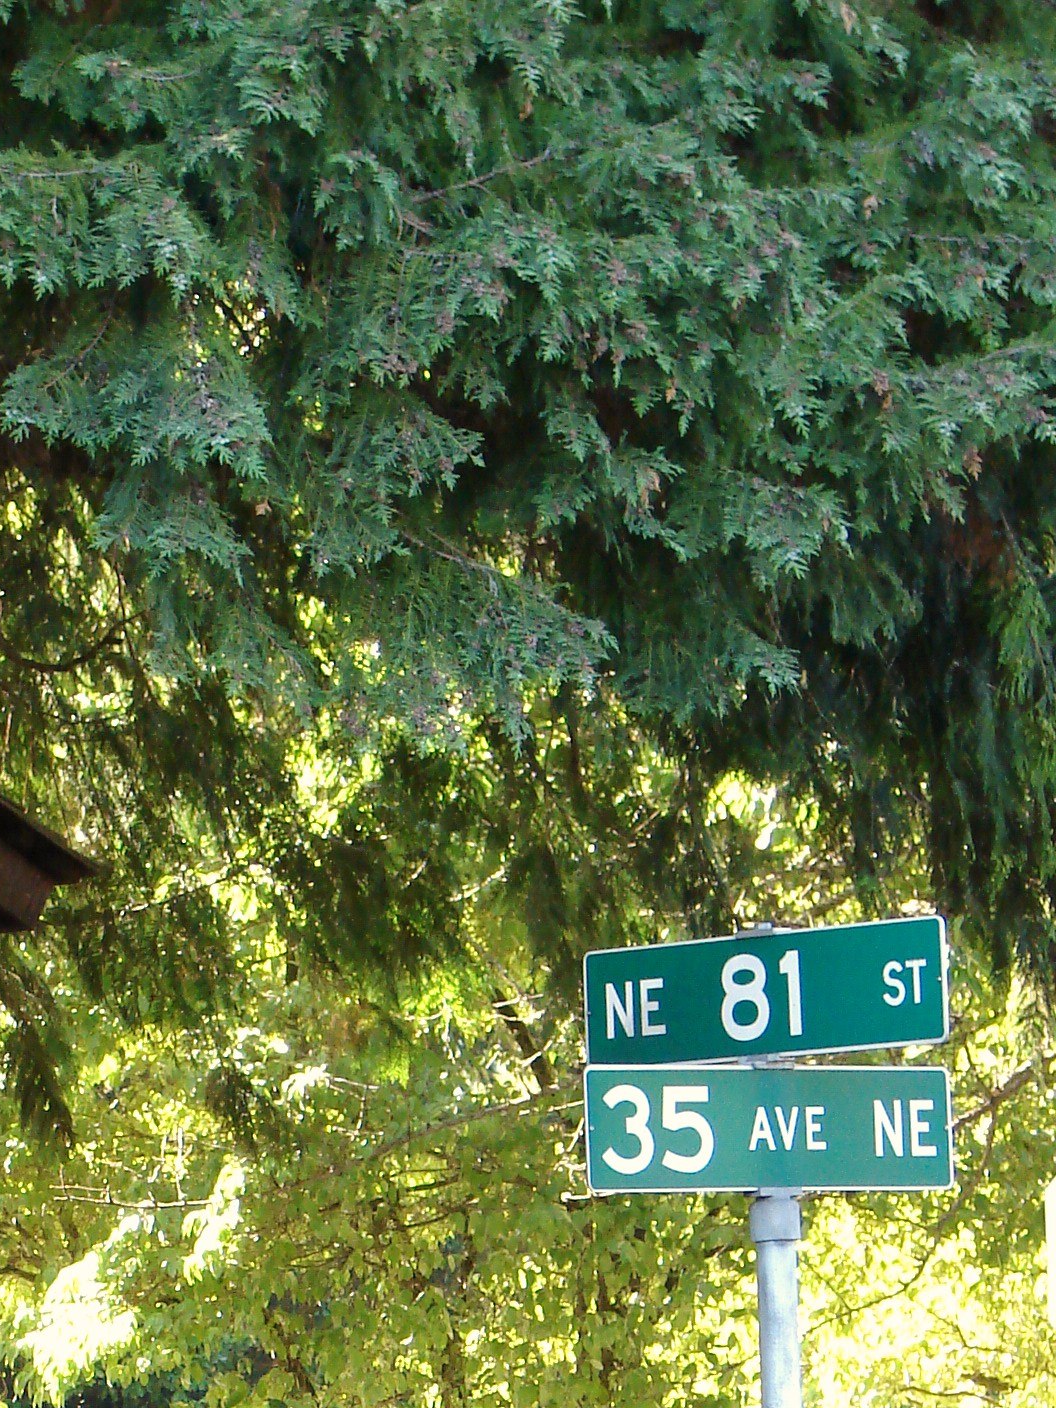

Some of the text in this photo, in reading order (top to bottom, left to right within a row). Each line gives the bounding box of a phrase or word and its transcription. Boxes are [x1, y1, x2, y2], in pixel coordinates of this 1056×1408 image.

[604, 949, 928, 1042] NE 81 ST
[601, 1083, 938, 1175] 35 AVE NE
